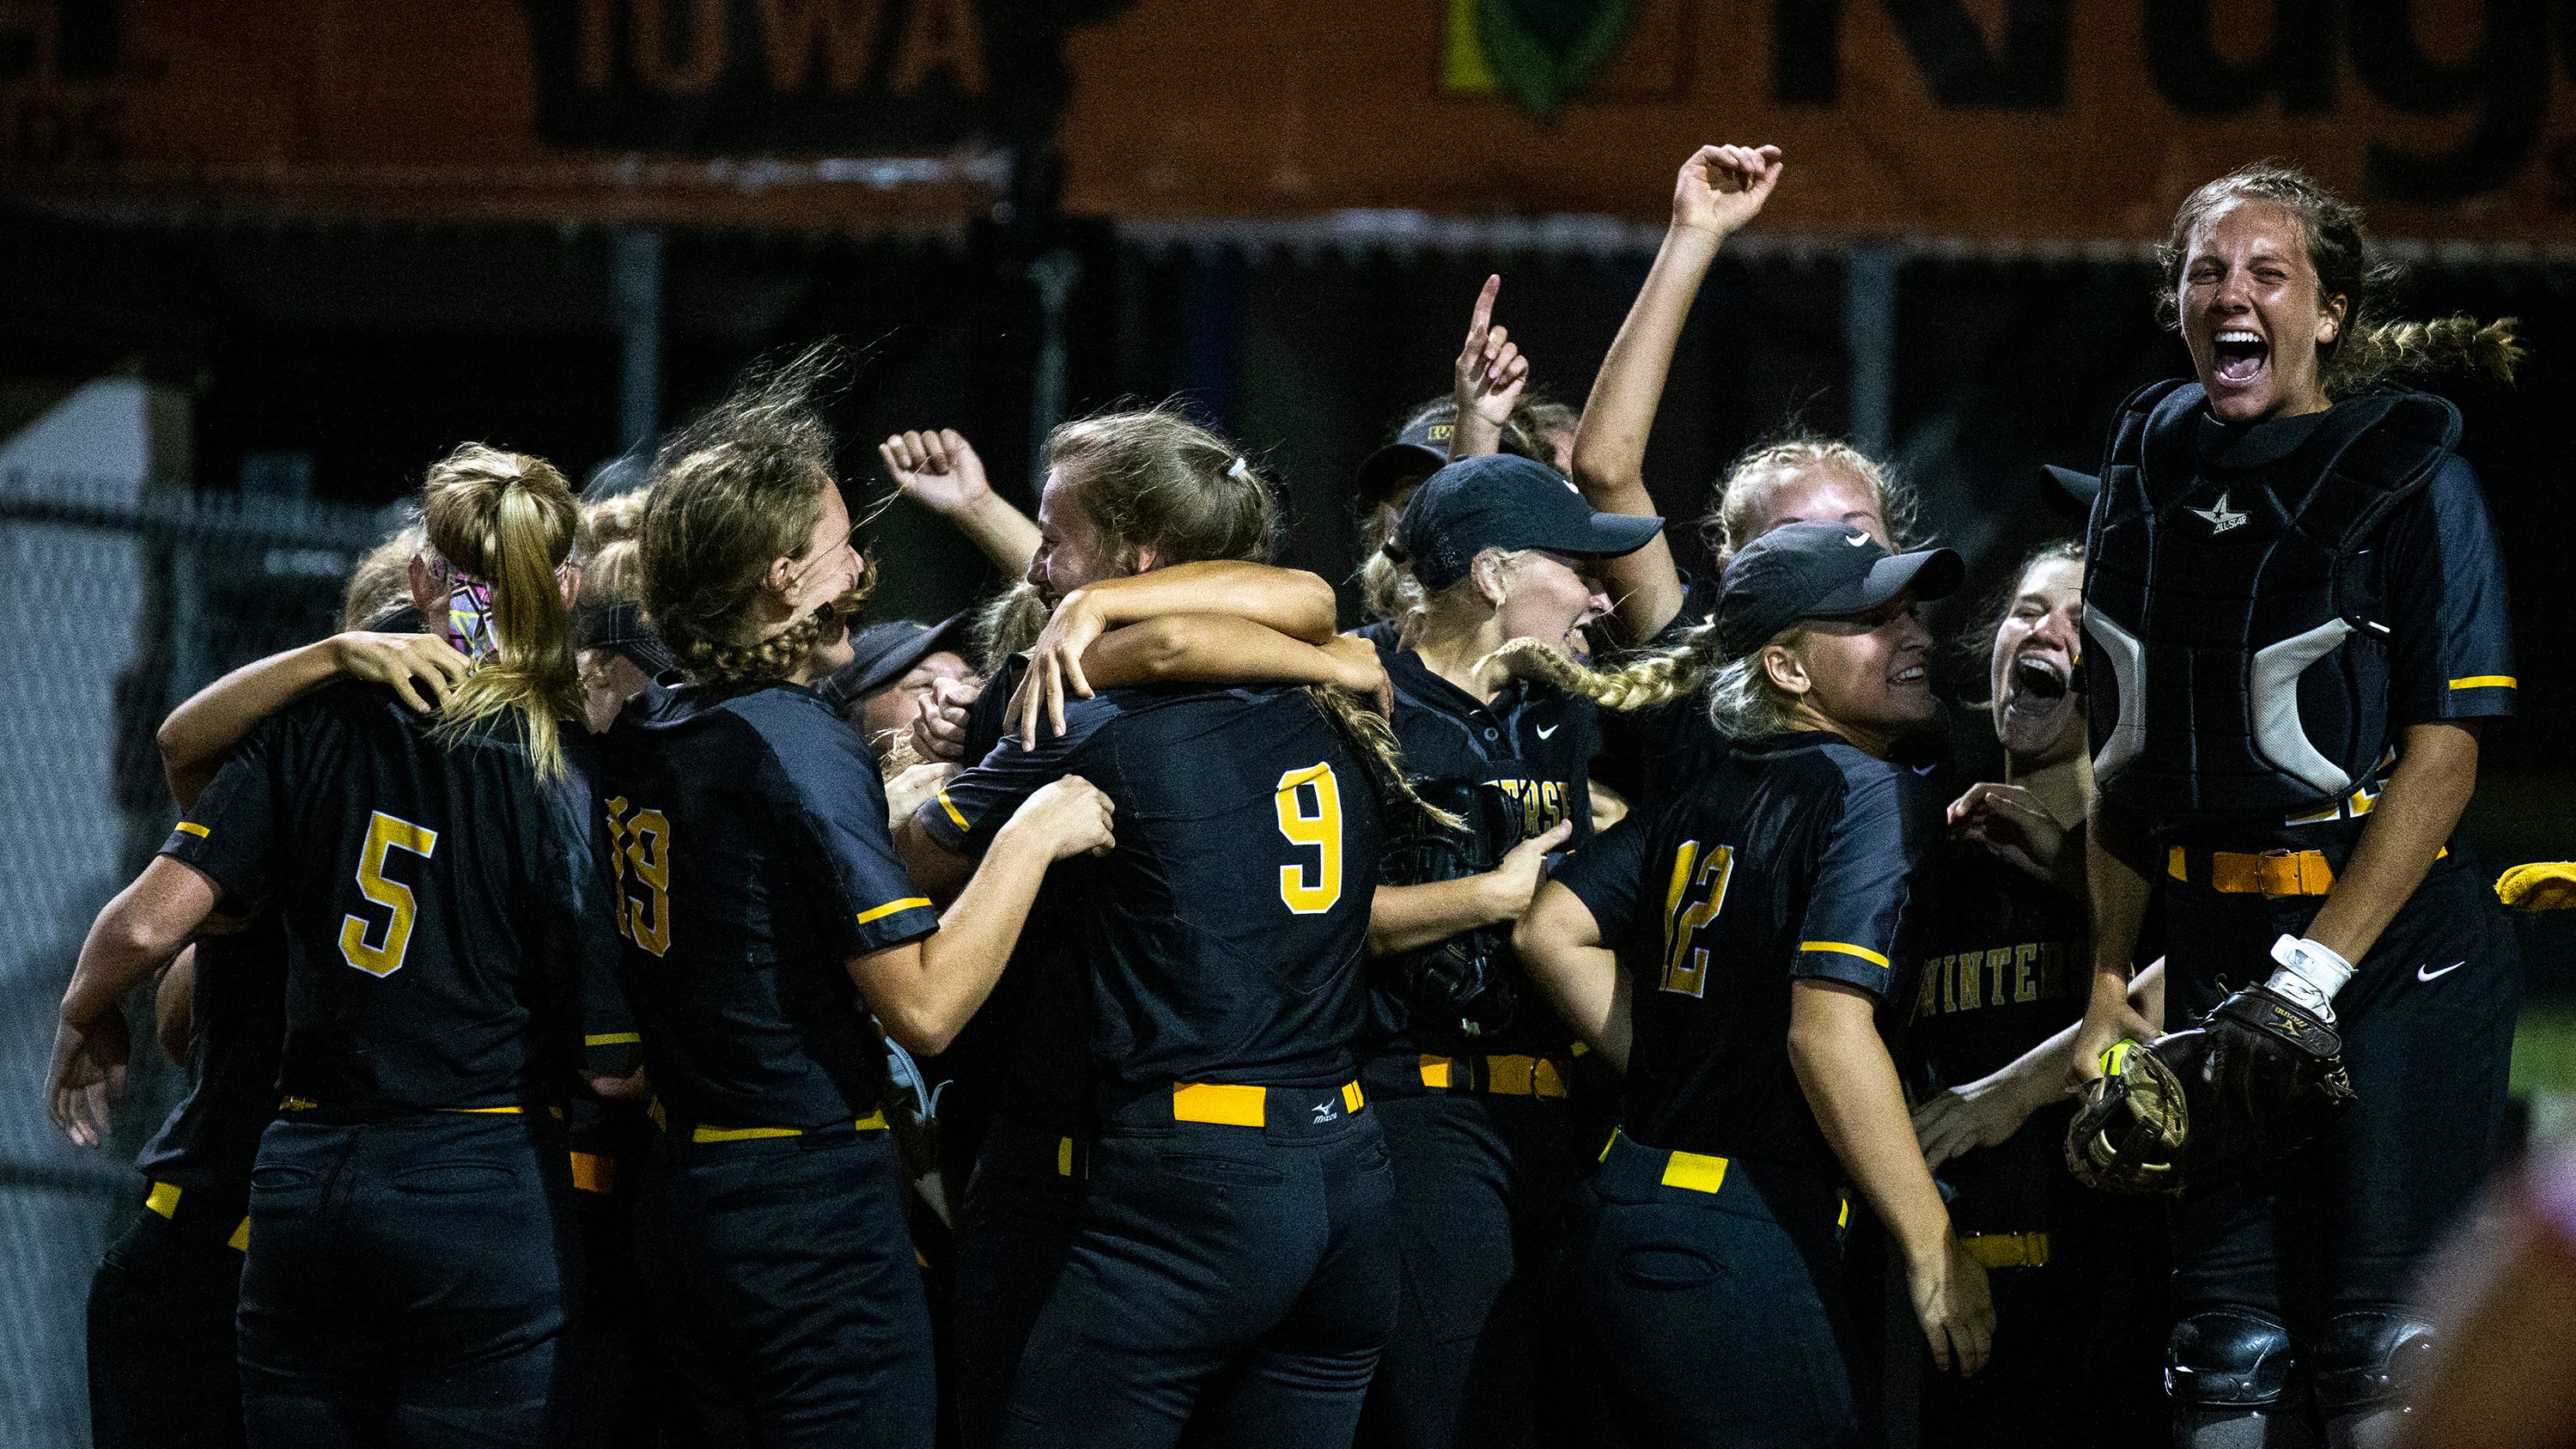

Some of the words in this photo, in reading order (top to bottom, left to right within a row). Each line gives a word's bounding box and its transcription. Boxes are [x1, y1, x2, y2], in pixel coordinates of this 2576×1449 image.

[1775, 0, 2576, 204] Nug
[338, 809, 439, 979] 5
[604, 795, 672, 959] 19
[1275, 761, 1343, 916] 9
[1659, 838, 1735, 999] 12
